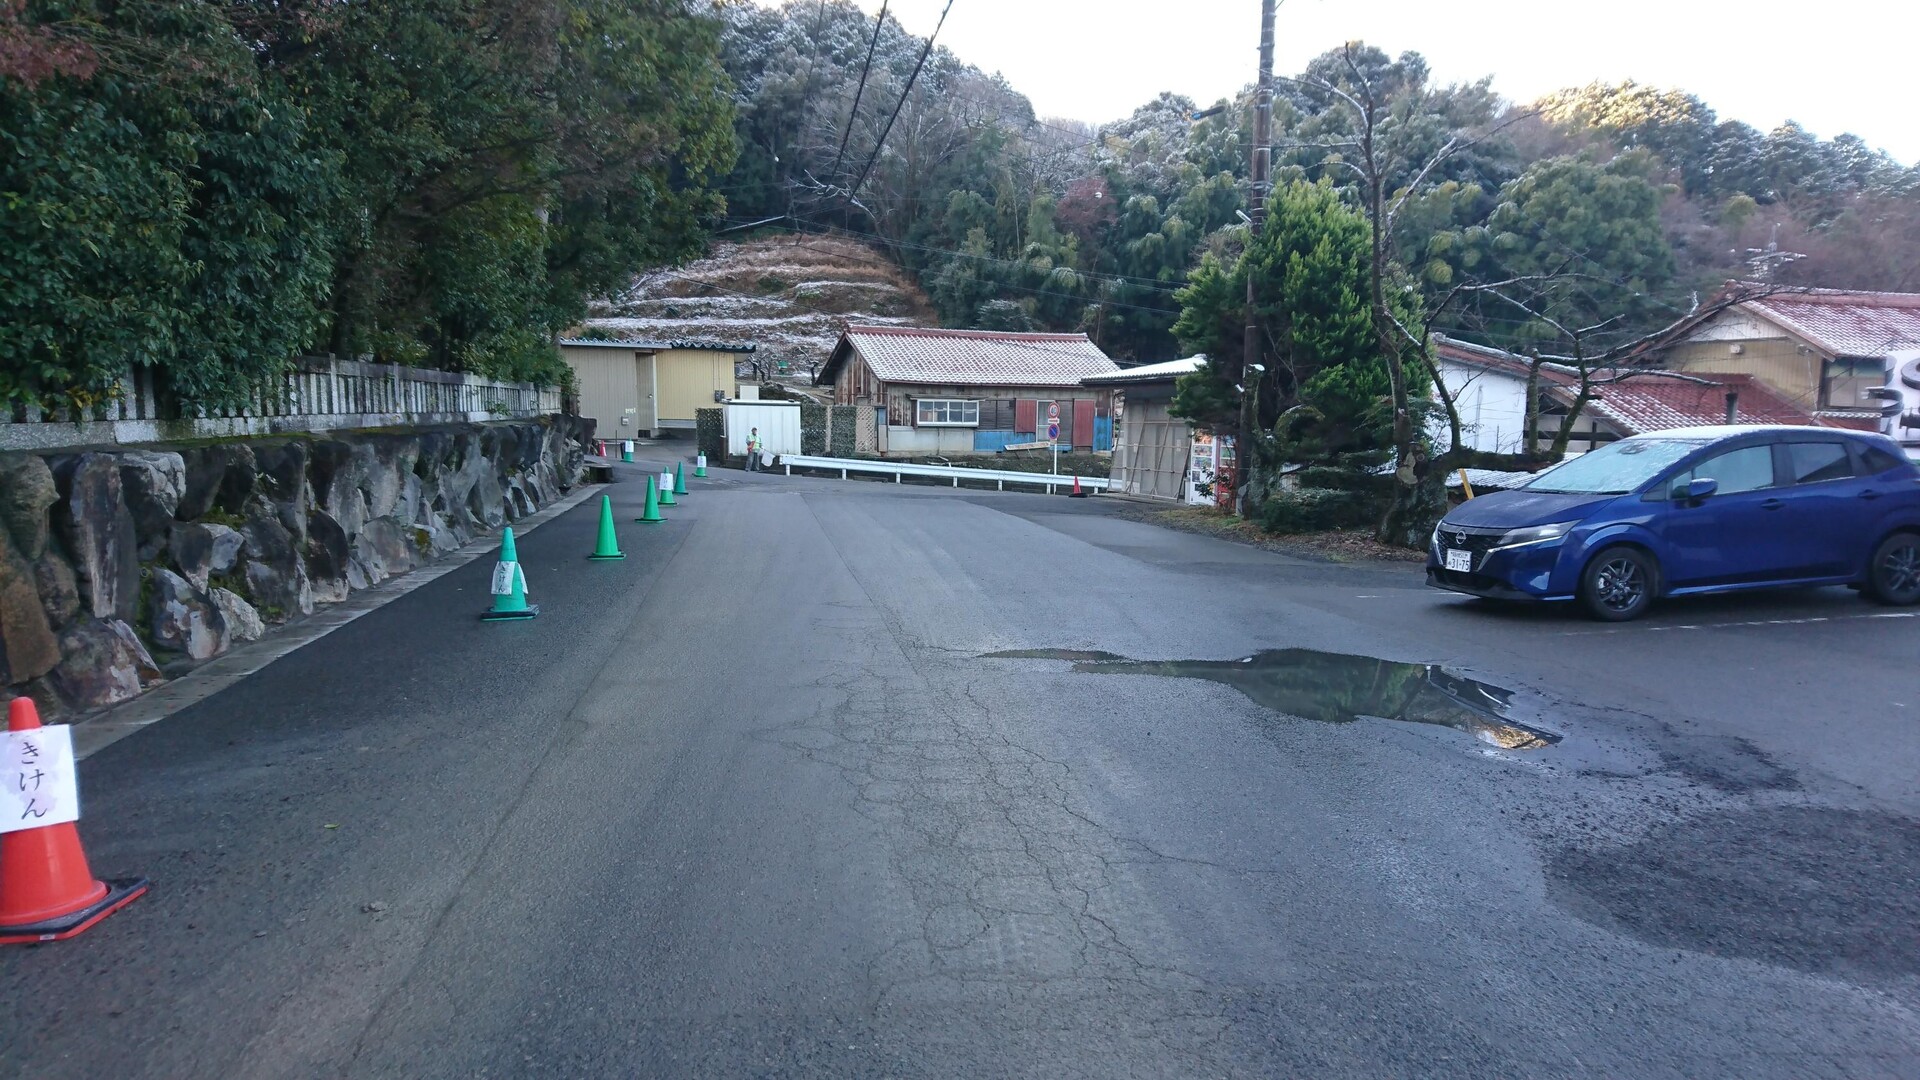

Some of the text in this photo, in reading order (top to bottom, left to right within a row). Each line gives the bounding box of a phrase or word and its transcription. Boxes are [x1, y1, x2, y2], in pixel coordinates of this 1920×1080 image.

[497, 564, 506, 592] きけん
[18, 741, 47, 820] きけん
